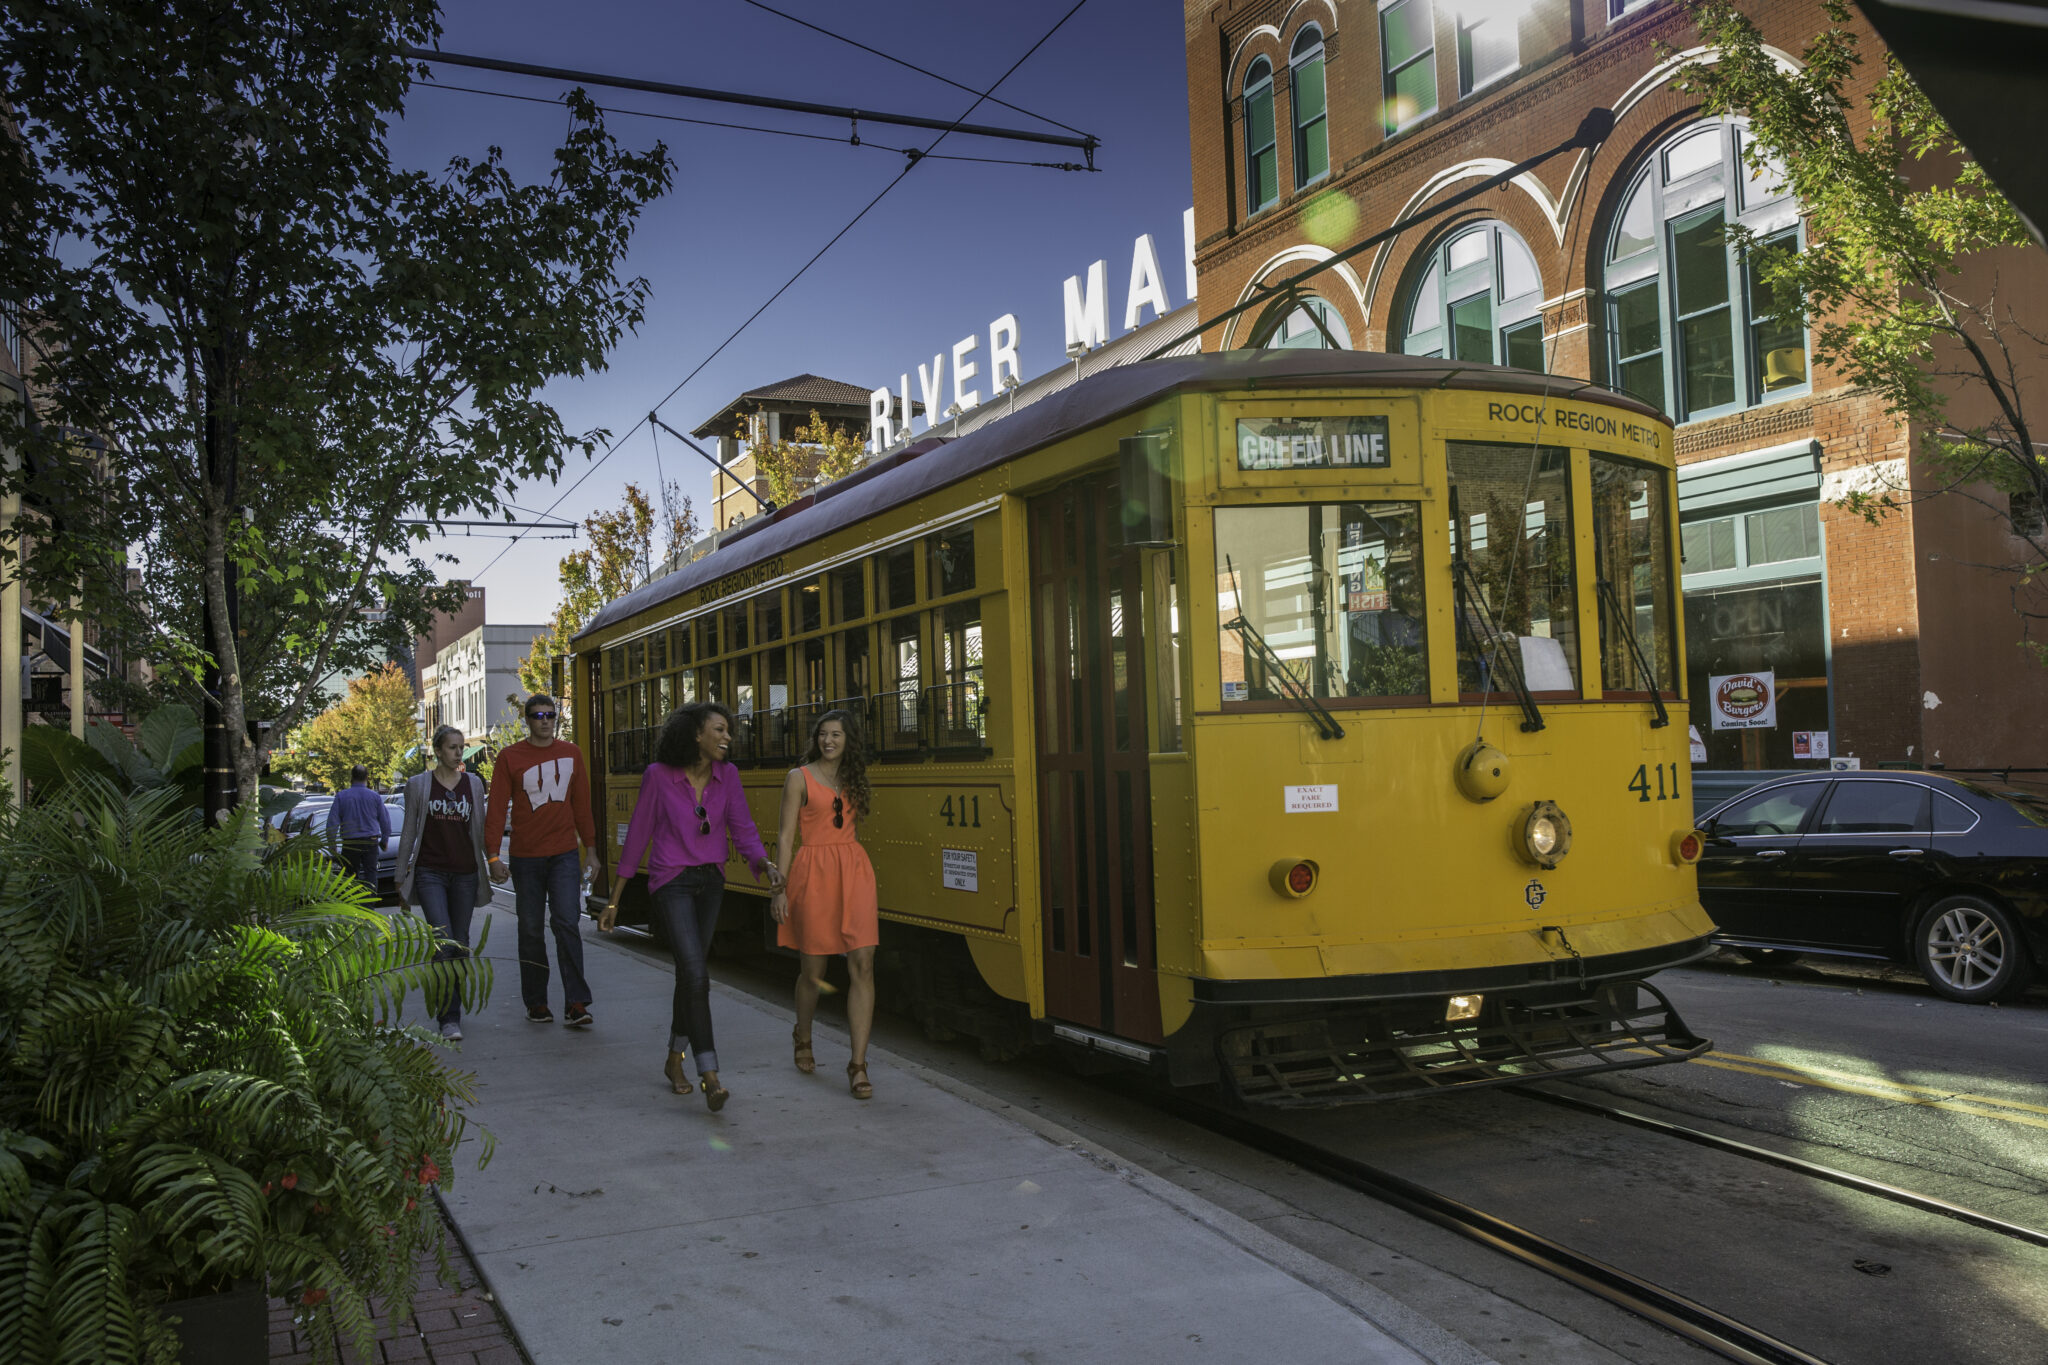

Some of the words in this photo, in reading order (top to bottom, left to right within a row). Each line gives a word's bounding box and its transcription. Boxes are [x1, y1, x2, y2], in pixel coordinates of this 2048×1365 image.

[870, 313, 1022, 456] RIVER
[1488, 402, 1547, 425] ROCK
[1555, 409, 1617, 436] REGION
[1622, 422, 1660, 449] METRO
[1242, 434, 1323, 466] GREEN
[1331, 433, 1385, 464] LINE
[700, 583, 719, 605] ROCK
[722, 571, 752, 597] REGION
[753, 557, 784, 584] METRO
[1714, 600, 1782, 635] OPEN
[1723, 678, 1763, 694] David's
[1722, 701, 1763, 717] Burgers
[1749, 718, 1768, 726] Soon!
[523, 757, 574, 812] W
[1628, 762, 1680, 802] 411
[939, 794, 981, 827] 411
